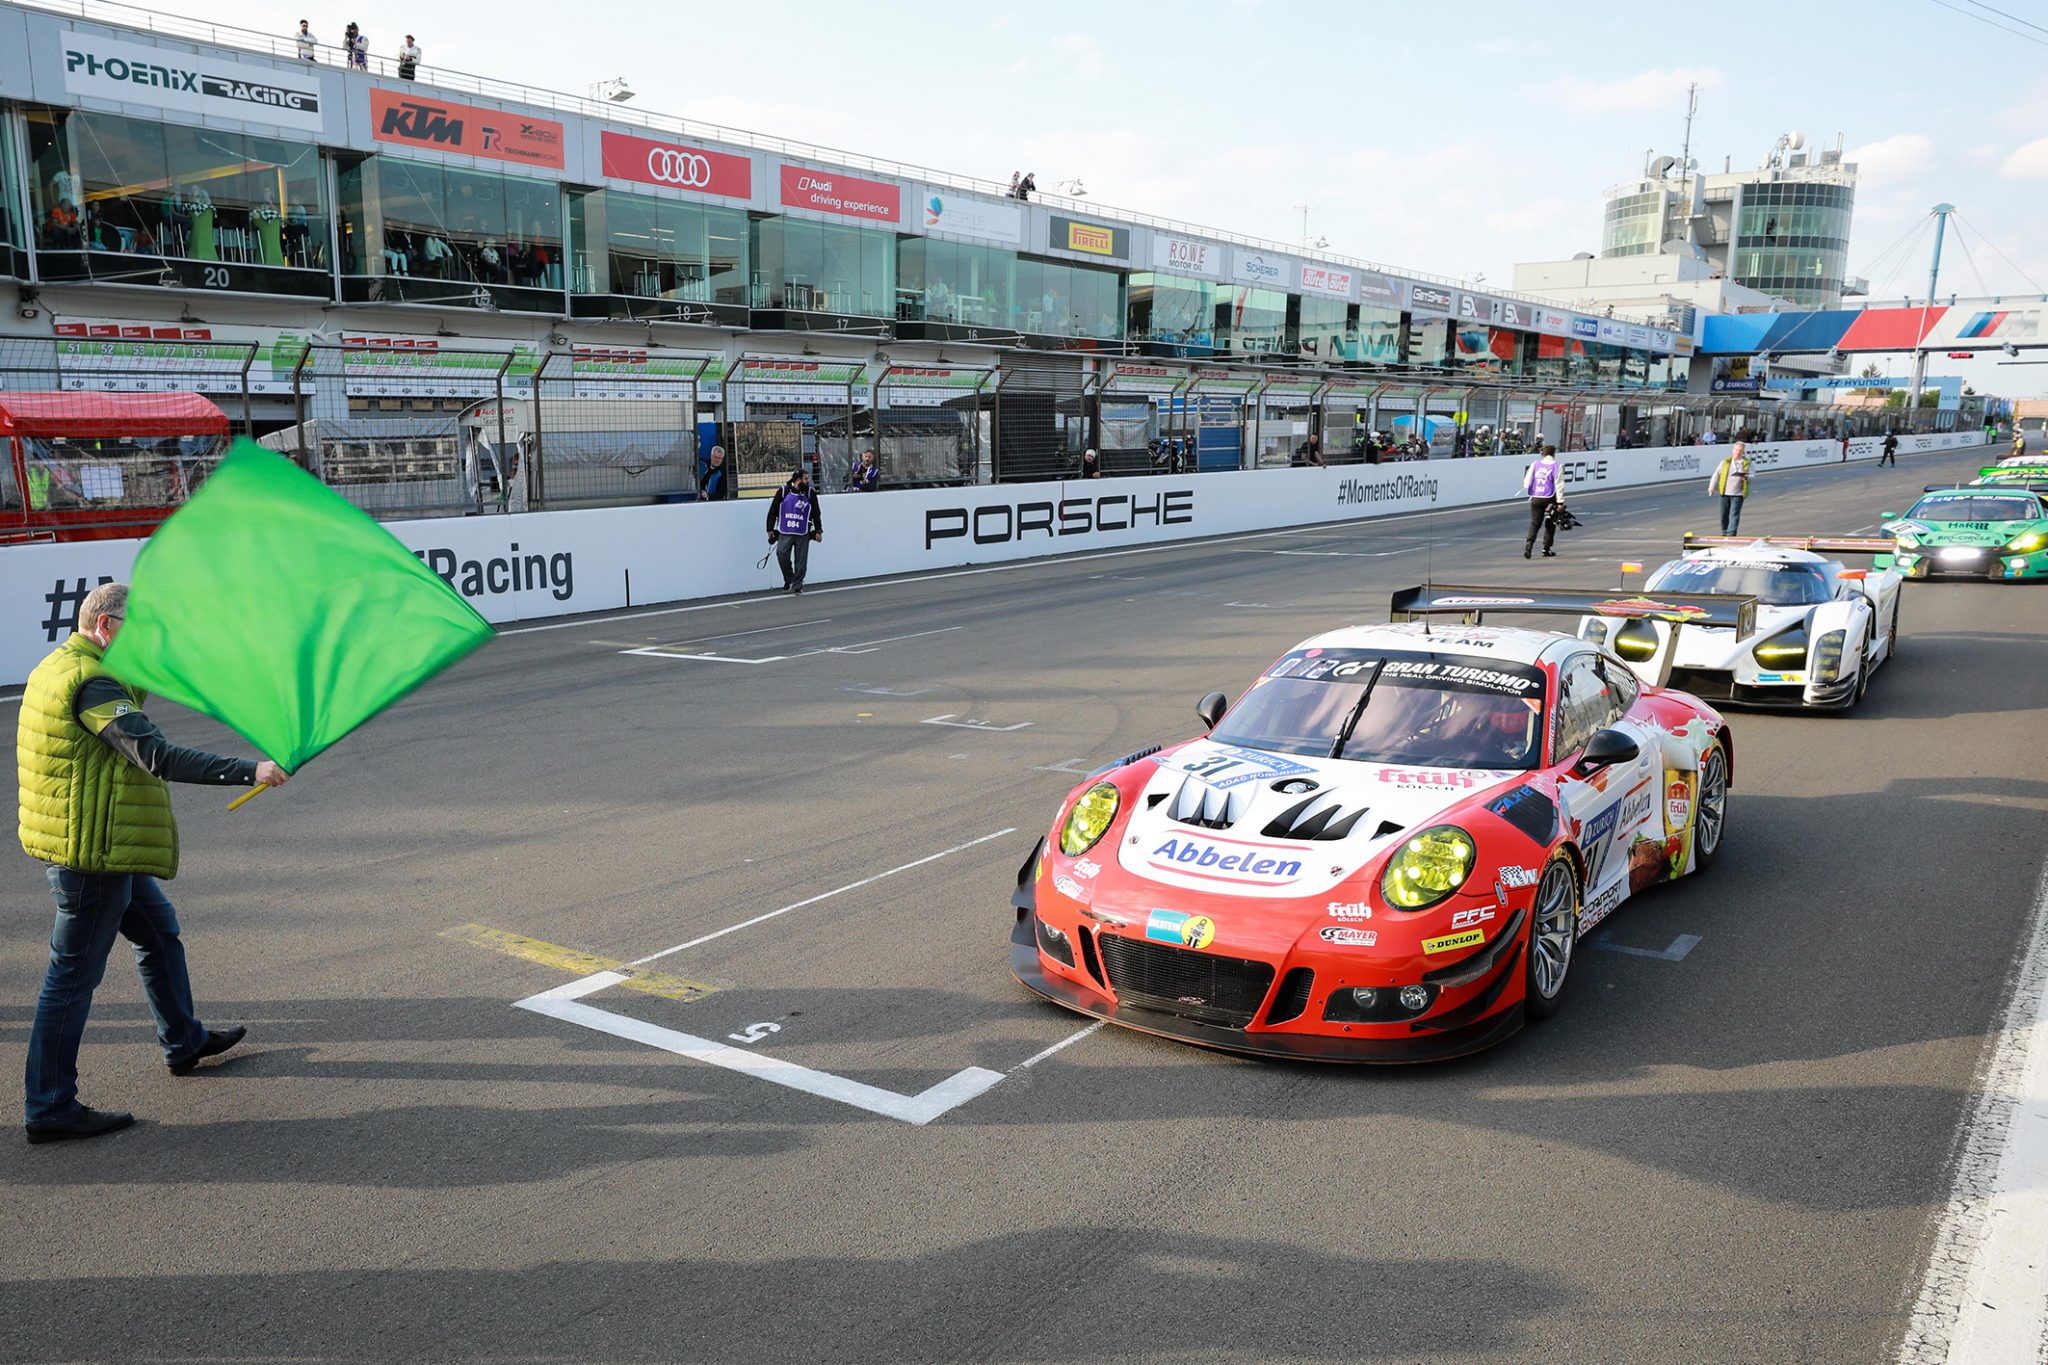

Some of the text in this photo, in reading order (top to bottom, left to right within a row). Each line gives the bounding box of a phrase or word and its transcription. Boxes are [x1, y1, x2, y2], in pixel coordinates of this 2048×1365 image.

[381, 102, 464, 146] KTM
[810, 178, 832, 192] Audi
[810, 193, 889, 216] driving experience
[1072, 227, 1109, 250] PIRELLI
[1169, 240, 1207, 264] ROWE
[1169, 259, 1203, 272] MOTOR OIL
[1246, 261, 1279, 278] SCHERER
[204, 266, 230, 288] 20
[675, 305, 691, 320] 18
[836, 318, 849, 331] 17
[967, 328, 978, 341] 16
[68, 343, 81, 353] 51
[101, 343, 114, 354] 52
[163, 346, 176, 357] 77
[191, 347, 208, 358] 151
[1726, 380, 1753, 389] ZURICH
[1843, 378, 1891, 387] HYUNDAI
[1337, 474, 1438, 505] #MomentsOfRacing
[785, 513, 804, 521] MEDIA
[925, 489, 1194, 551] PORSCHE
[1425, 636, 1495, 649] TEAM
[1382, 660, 1436, 674] GRAN
[1440, 664, 1532, 691] TURISMO
[1399, 672, 1423, 680] REAL
[1425, 674, 1464, 684] DRIVING
[1465, 679, 1522, 696] SIMULATOR
[1182, 756, 1245, 778] 31
[1237, 748, 1294, 771] ZURICH
[1218, 775, 1248, 788] ADAC
[1619, 792, 1651, 831] Abbelen
[1591, 808, 1616, 836] ZURICH
[1153, 839, 1303, 877] Abbelen
[1326, 901, 1373, 920] früh
[1452, 904, 1497, 925] PFC
[1337, 930, 1377, 940] MAYER
[1436, 932, 1481, 950] DUNLOP
[727, 1021, 782, 1044] 5
